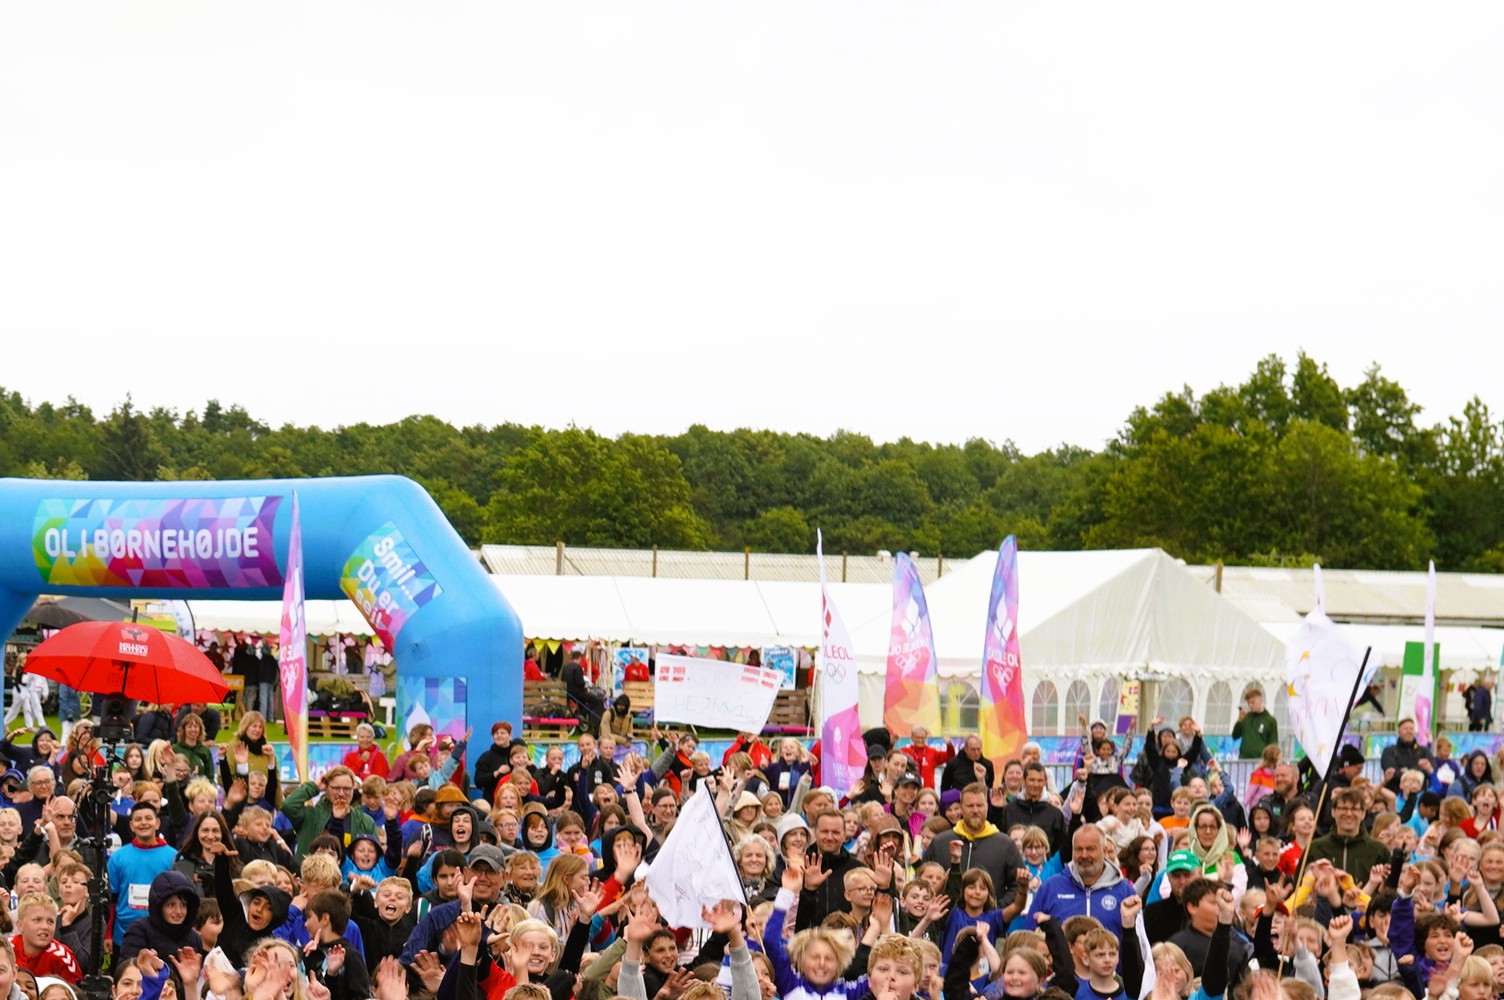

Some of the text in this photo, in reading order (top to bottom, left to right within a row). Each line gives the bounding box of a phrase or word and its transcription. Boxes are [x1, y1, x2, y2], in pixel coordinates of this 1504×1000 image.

[45, 527, 259, 559] OL I BØRNEHØJDE
[374, 537, 414, 600] Smil...
[357, 559, 399, 614] Du er
